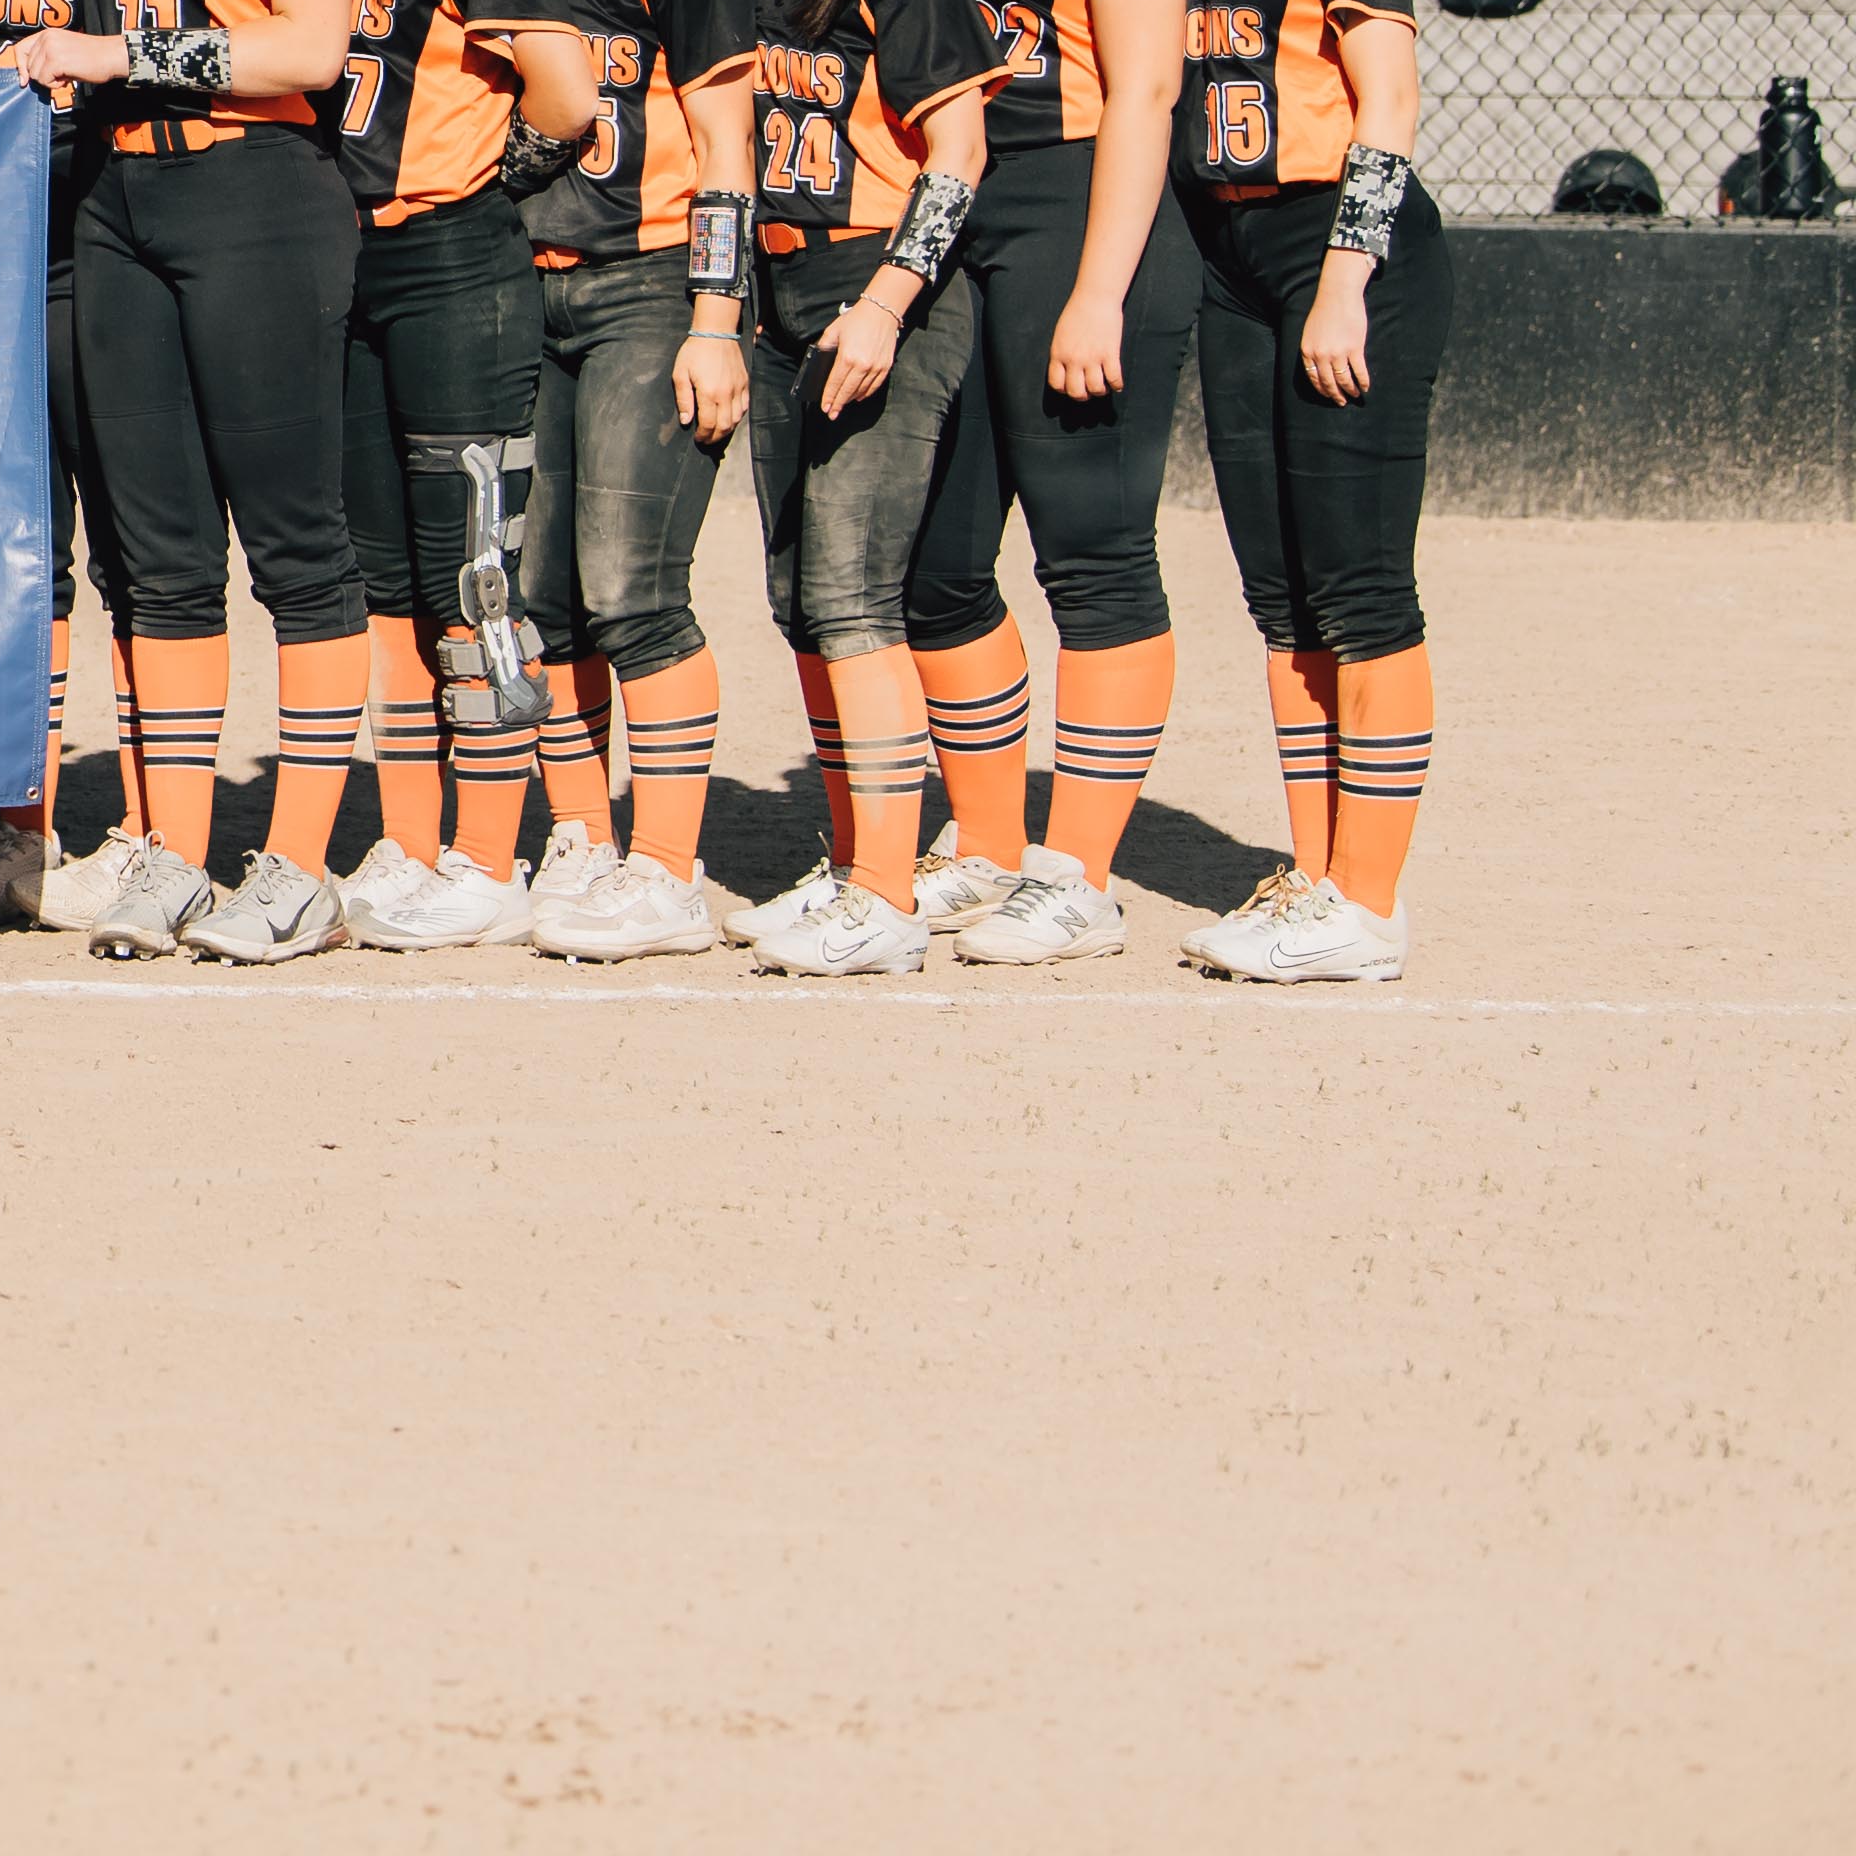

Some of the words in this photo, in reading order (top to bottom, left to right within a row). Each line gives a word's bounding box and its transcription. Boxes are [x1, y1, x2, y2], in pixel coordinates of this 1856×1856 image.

[763, 108, 839, 194] 24
[1205, 81, 1270, 165] 15
[1052, 904, 1089, 938] N
